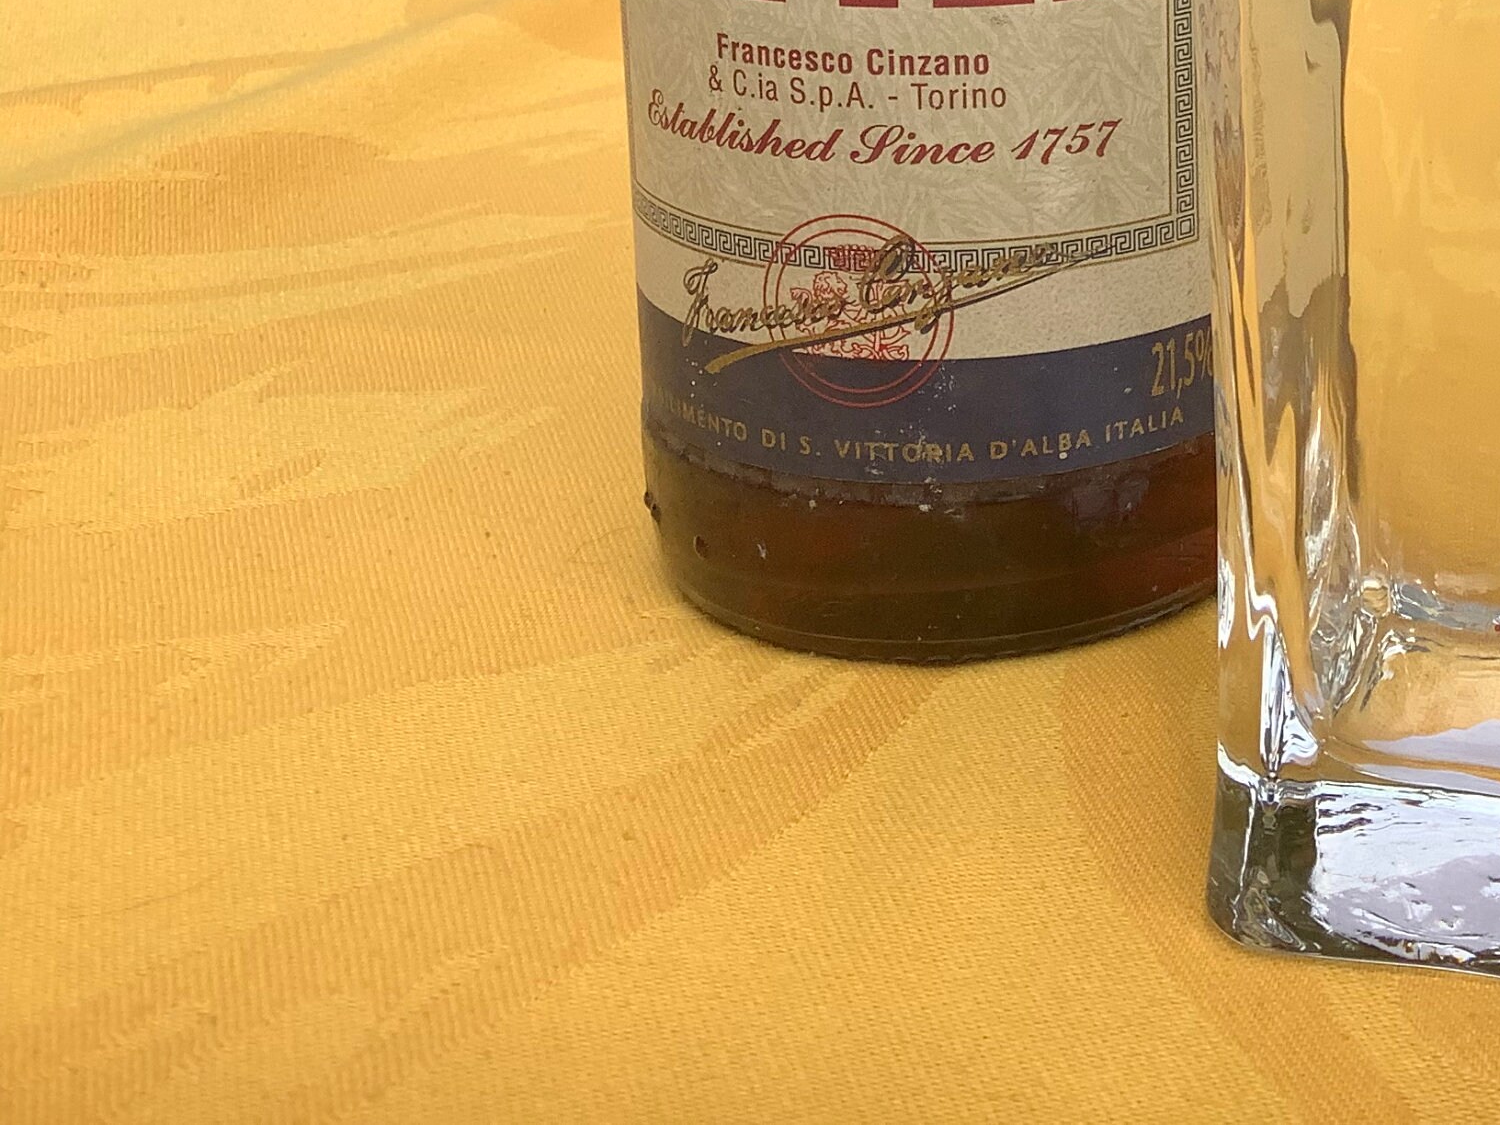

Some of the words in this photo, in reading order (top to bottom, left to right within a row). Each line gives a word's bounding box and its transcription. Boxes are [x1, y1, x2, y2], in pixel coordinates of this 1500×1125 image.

[716, 32, 852, 75] Francesco
[866, 48, 989, 75] Cinzano
[708, 65, 724, 92] &
[733, 69, 778, 101] C.ia
[790, 77, 874, 112] S.p.A.
[910, 82, 1007, 110] Torino
[648, 89, 844, 162] Established
[851, 124, 995, 165] Since
[1011, 118, 1124, 166] 1757
[1151, 326, 1213, 399] 21,5%
[762, 428, 786, 451] DI
[799, 436, 821, 457] S.
[834, 439, 975, 463] VITTORIA
[990, 429, 1091, 460] D'ALBA
[1105, 406, 1184, 443] ITALIA
